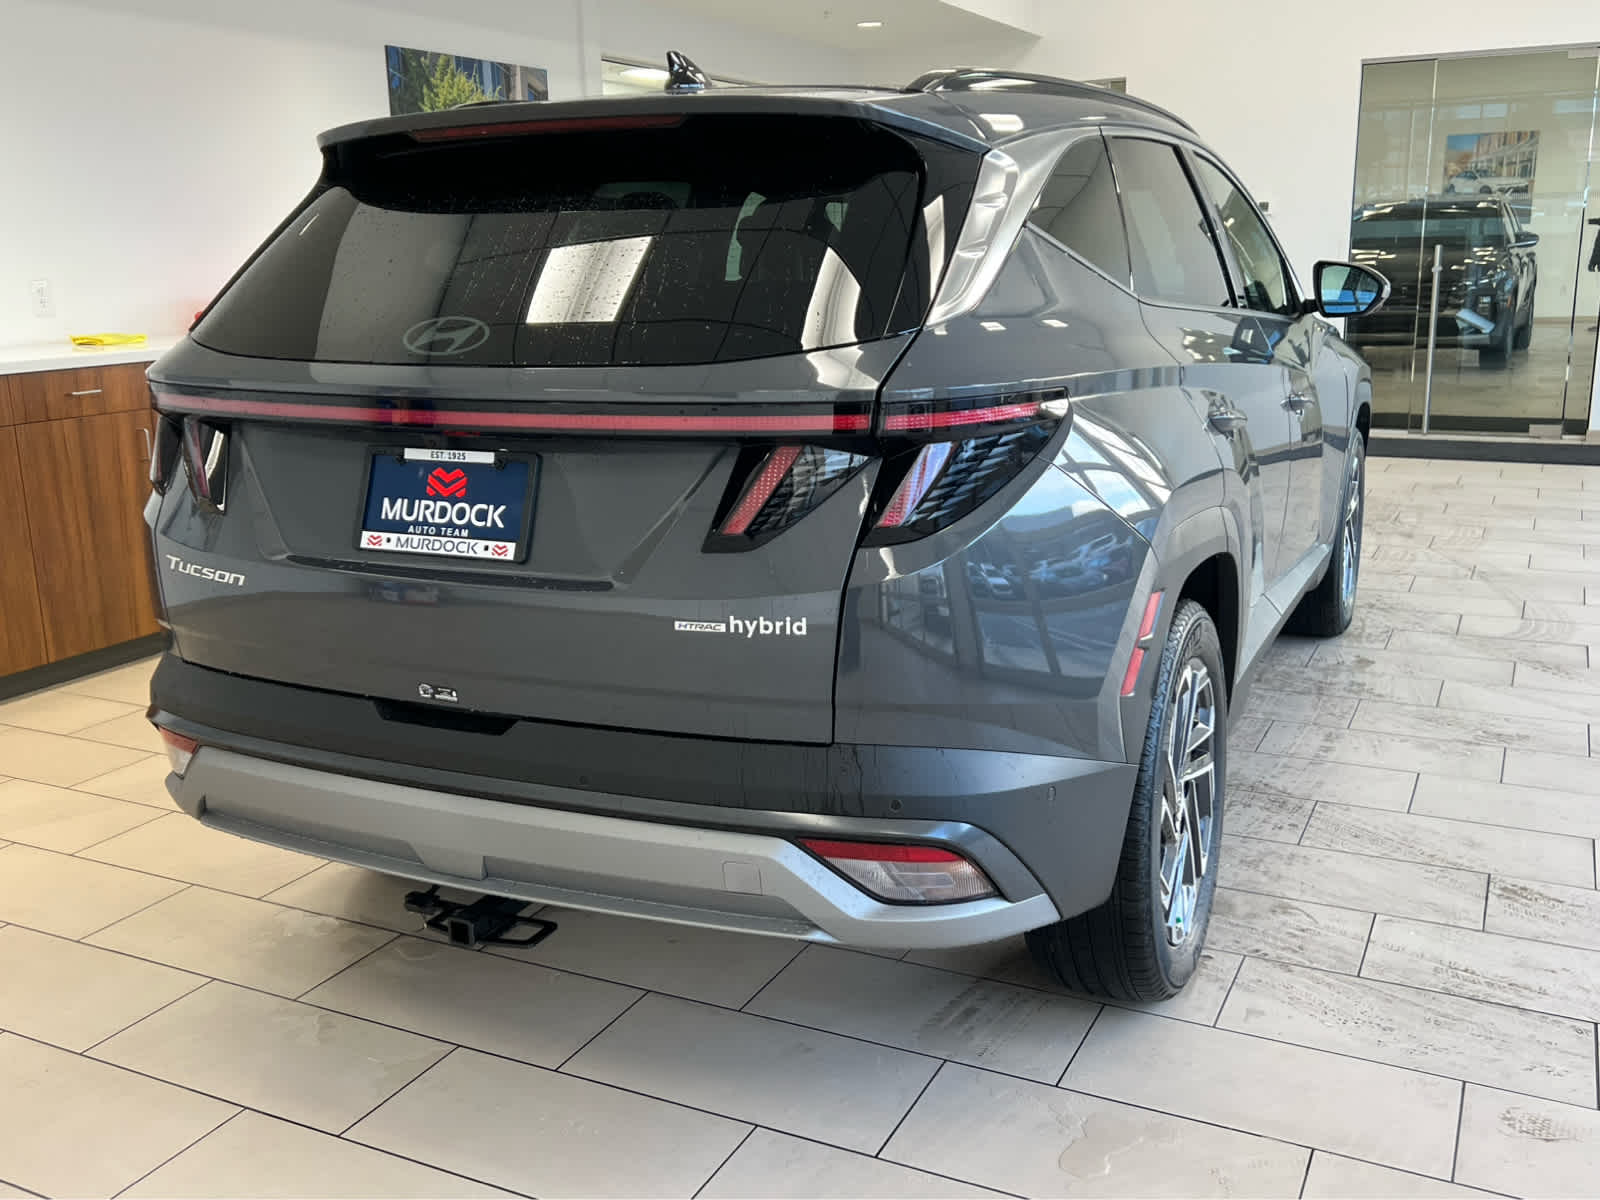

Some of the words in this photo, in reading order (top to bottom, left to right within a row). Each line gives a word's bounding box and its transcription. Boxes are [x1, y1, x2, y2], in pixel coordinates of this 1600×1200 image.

[448, 452, 467, 460] 1925
[381, 497, 507, 529] MURDOCK
[407, 525, 436, 536] AUTO
[440, 527, 469, 538] TEAM
[395, 535, 479, 555] MURDOCK
[676, 622, 724, 632] HTRAC
[729, 615, 807, 638] hybrid
